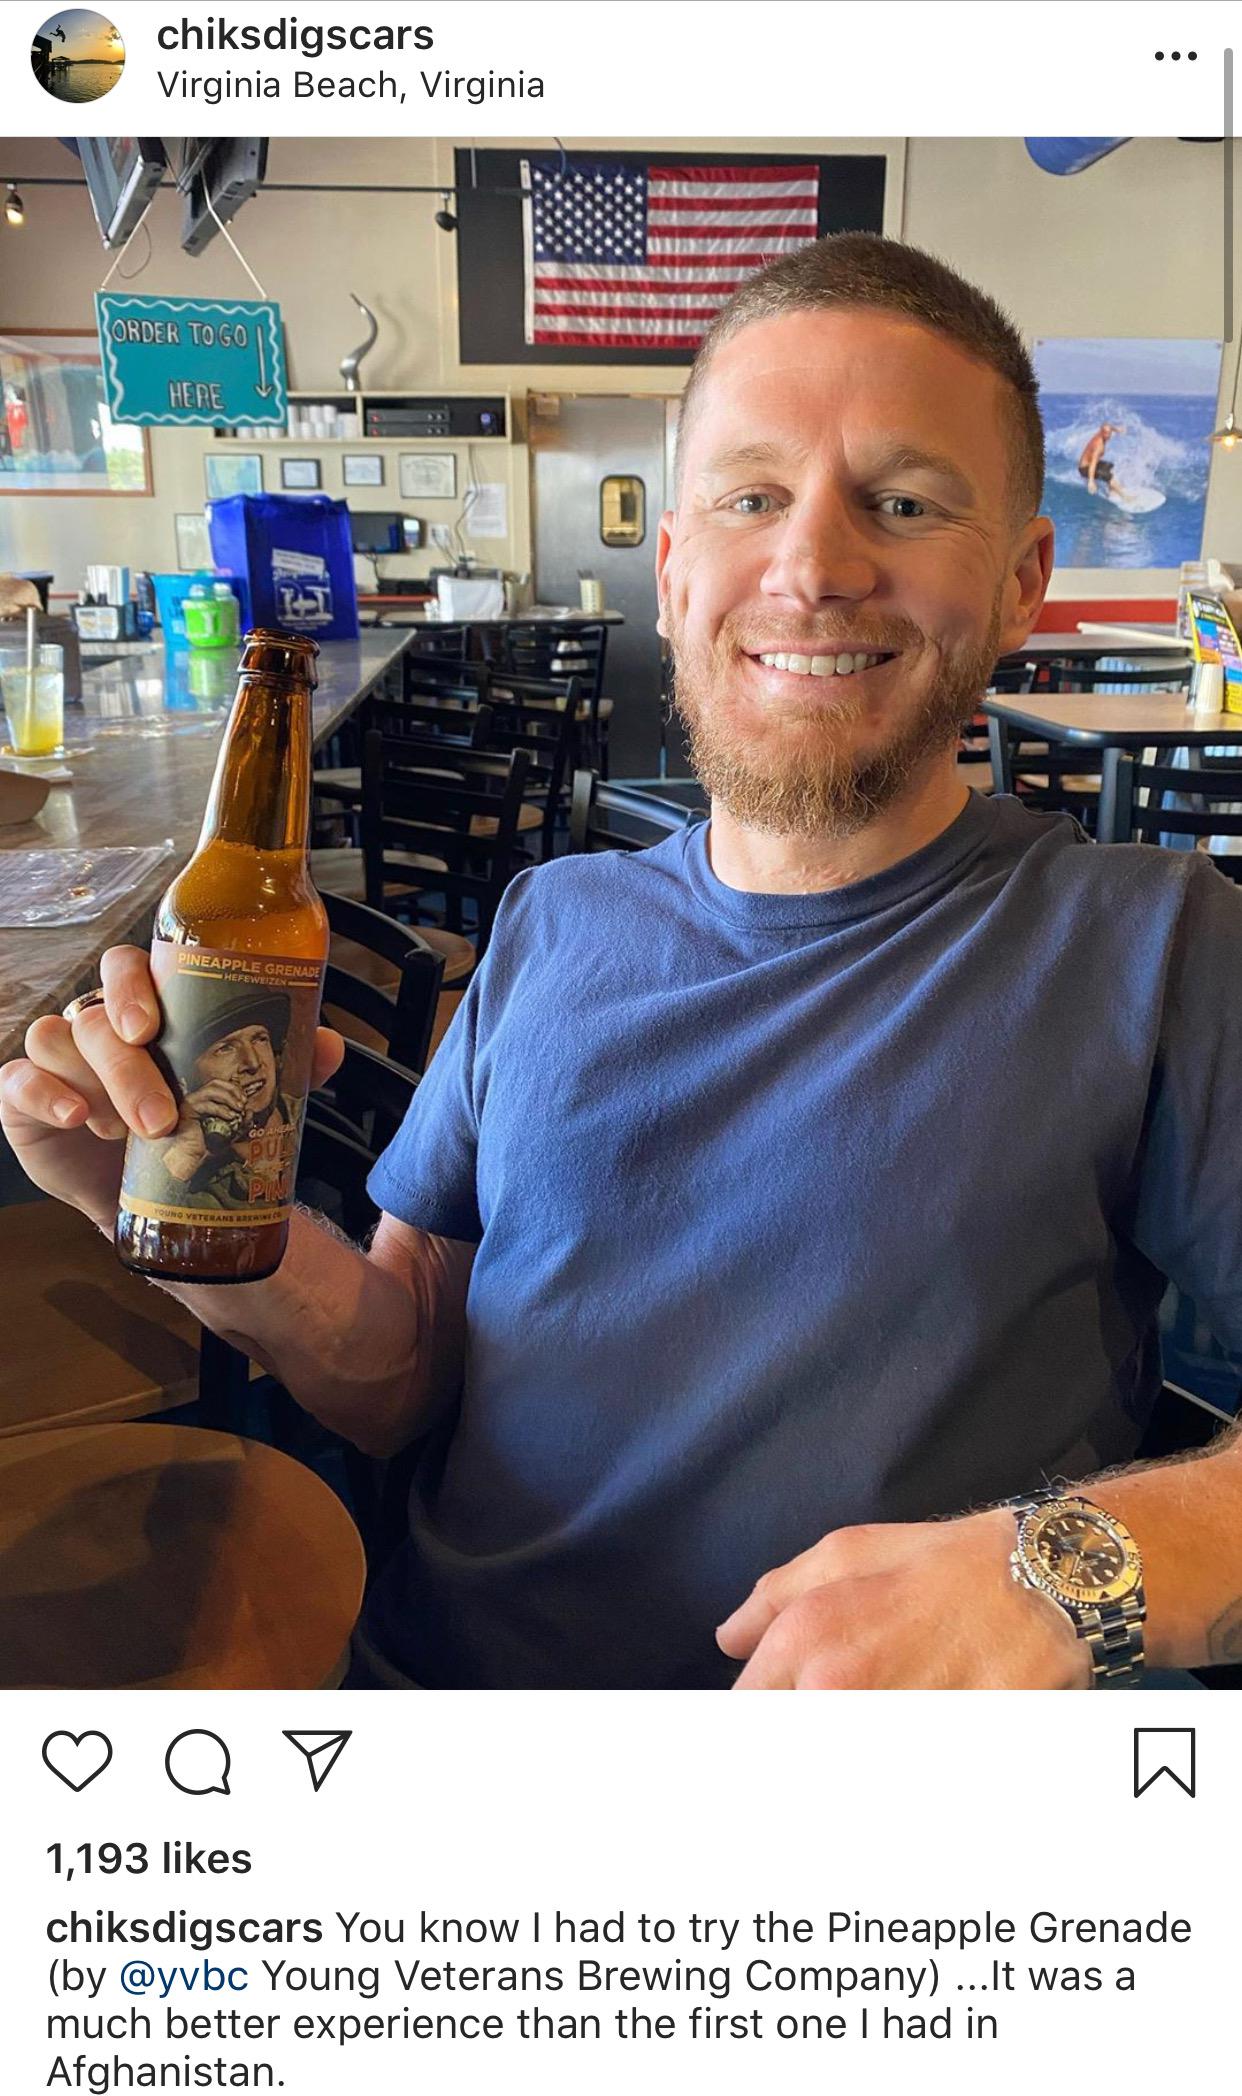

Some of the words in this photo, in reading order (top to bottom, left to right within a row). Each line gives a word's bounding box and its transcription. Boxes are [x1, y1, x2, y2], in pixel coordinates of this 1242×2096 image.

[111, 318, 180, 345] ORDER
[168, 380, 225, 410] HERE
[178, 952, 262, 974] PINEAPPLE
[264, 963, 321, 979] GRENADE
[248, 1127, 265, 1139] GO
[154, 1207, 184, 1220] YOUNG
[185, 1212, 235, 1223] VETERANS
